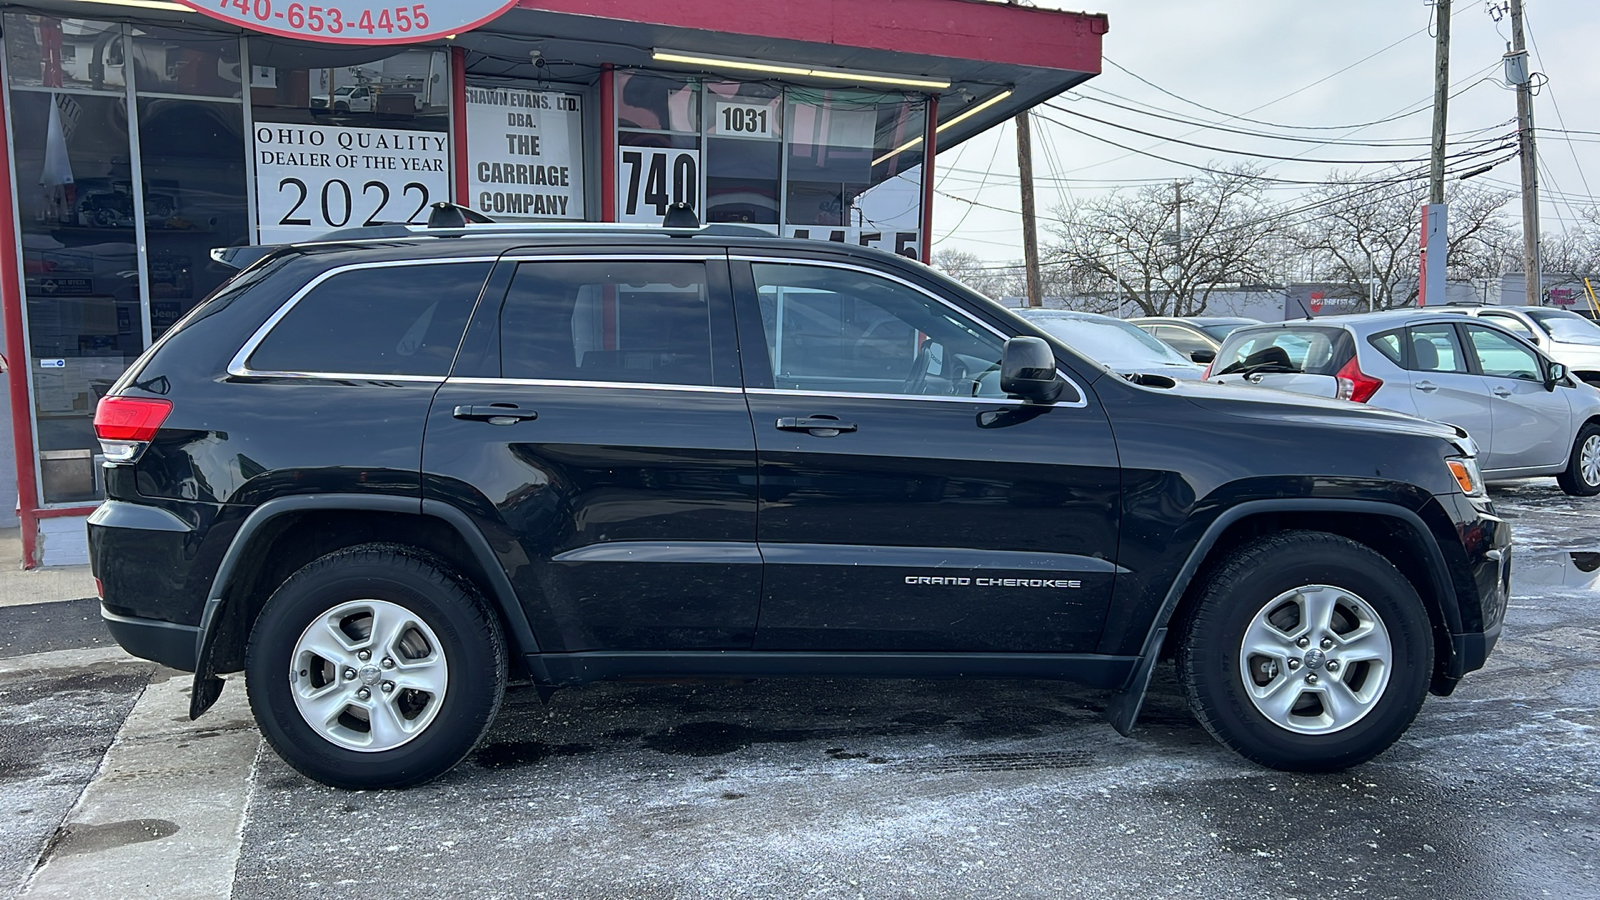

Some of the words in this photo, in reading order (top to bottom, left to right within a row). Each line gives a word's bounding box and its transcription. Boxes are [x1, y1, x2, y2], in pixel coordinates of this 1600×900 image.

[465, 88, 507, 106] SHAWN
[557, 96, 580, 112] LTD.
[508, 112, 537, 128] DBA.
[722, 107, 767, 133] 1031
[257, 127, 325, 146] OHIO
[337, 131, 446, 152] QUALITY
[505, 133, 540, 156] THE
[260, 150, 331, 167] DEALER
[335, 154, 358, 168] OF
[362, 155, 397, 169] THE
[400, 157, 444, 172] YEAR
[477, 161, 569, 187] CARRIAGE
[622, 151, 697, 216] 740
[278, 177, 430, 227] 2022
[479, 191, 569, 216] COMPANY
[904, 576, 971, 586] GRAND
[975, 578, 1082, 588] CHEROKEE
